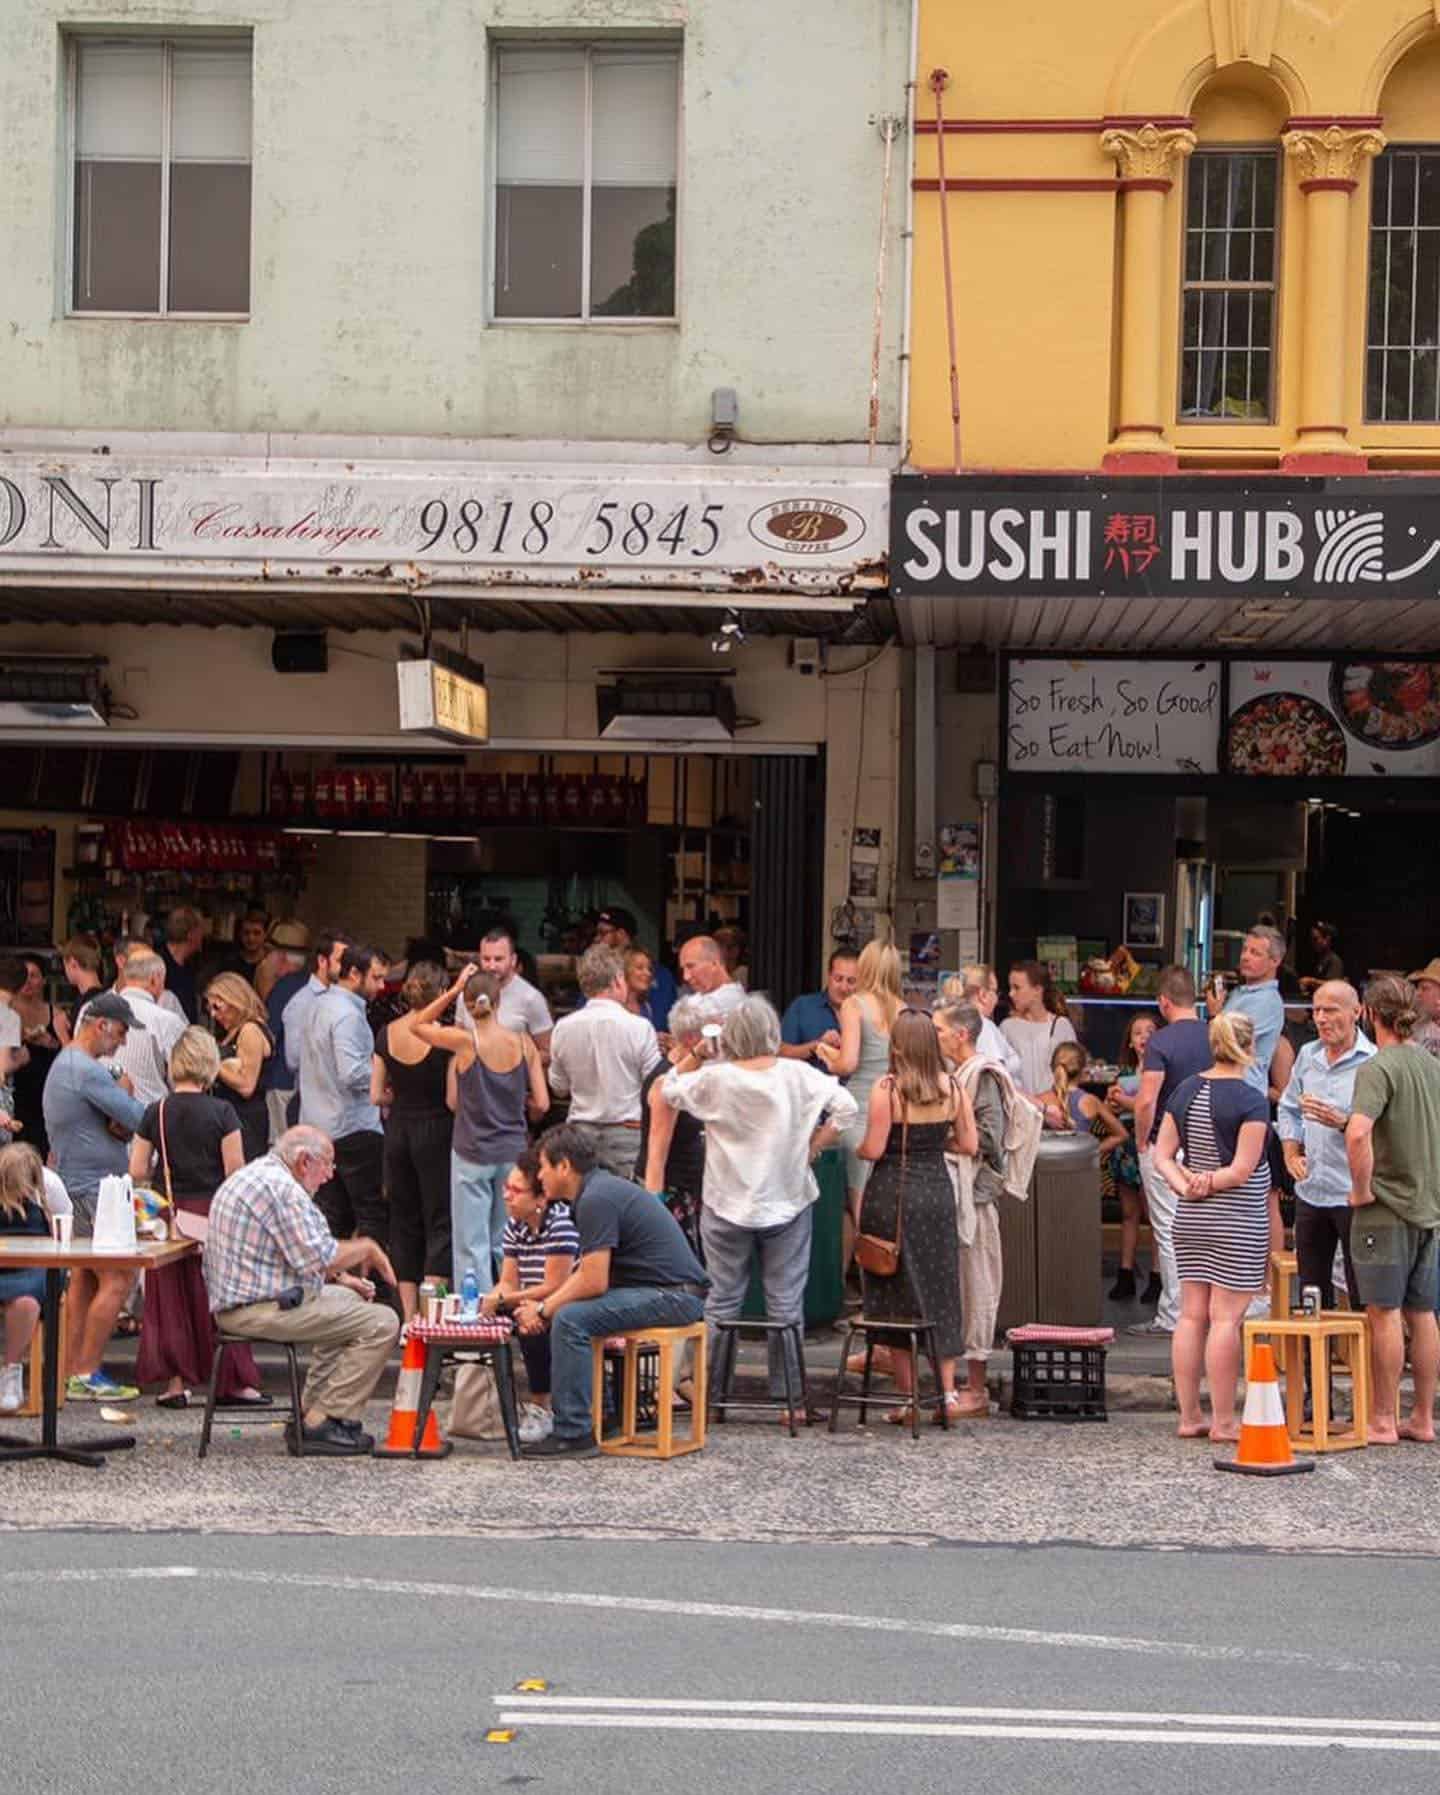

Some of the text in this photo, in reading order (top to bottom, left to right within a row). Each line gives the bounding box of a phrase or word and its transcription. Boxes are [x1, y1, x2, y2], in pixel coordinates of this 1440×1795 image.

[189, 501, 383, 555] Casalinga
[416, 499, 724, 556] 9818 5845
[785, 541, 830, 552] COFFEE
[903, 507, 1304, 582] SUSHI HUB
[1104, 512, 1157, 543] 寿司
[1009, 679, 1041, 714] So
[1116, 679, 1149, 716] So
[1157, 681, 1218, 718] Good
[1009, 722, 1161, 760] So Eat Now!
